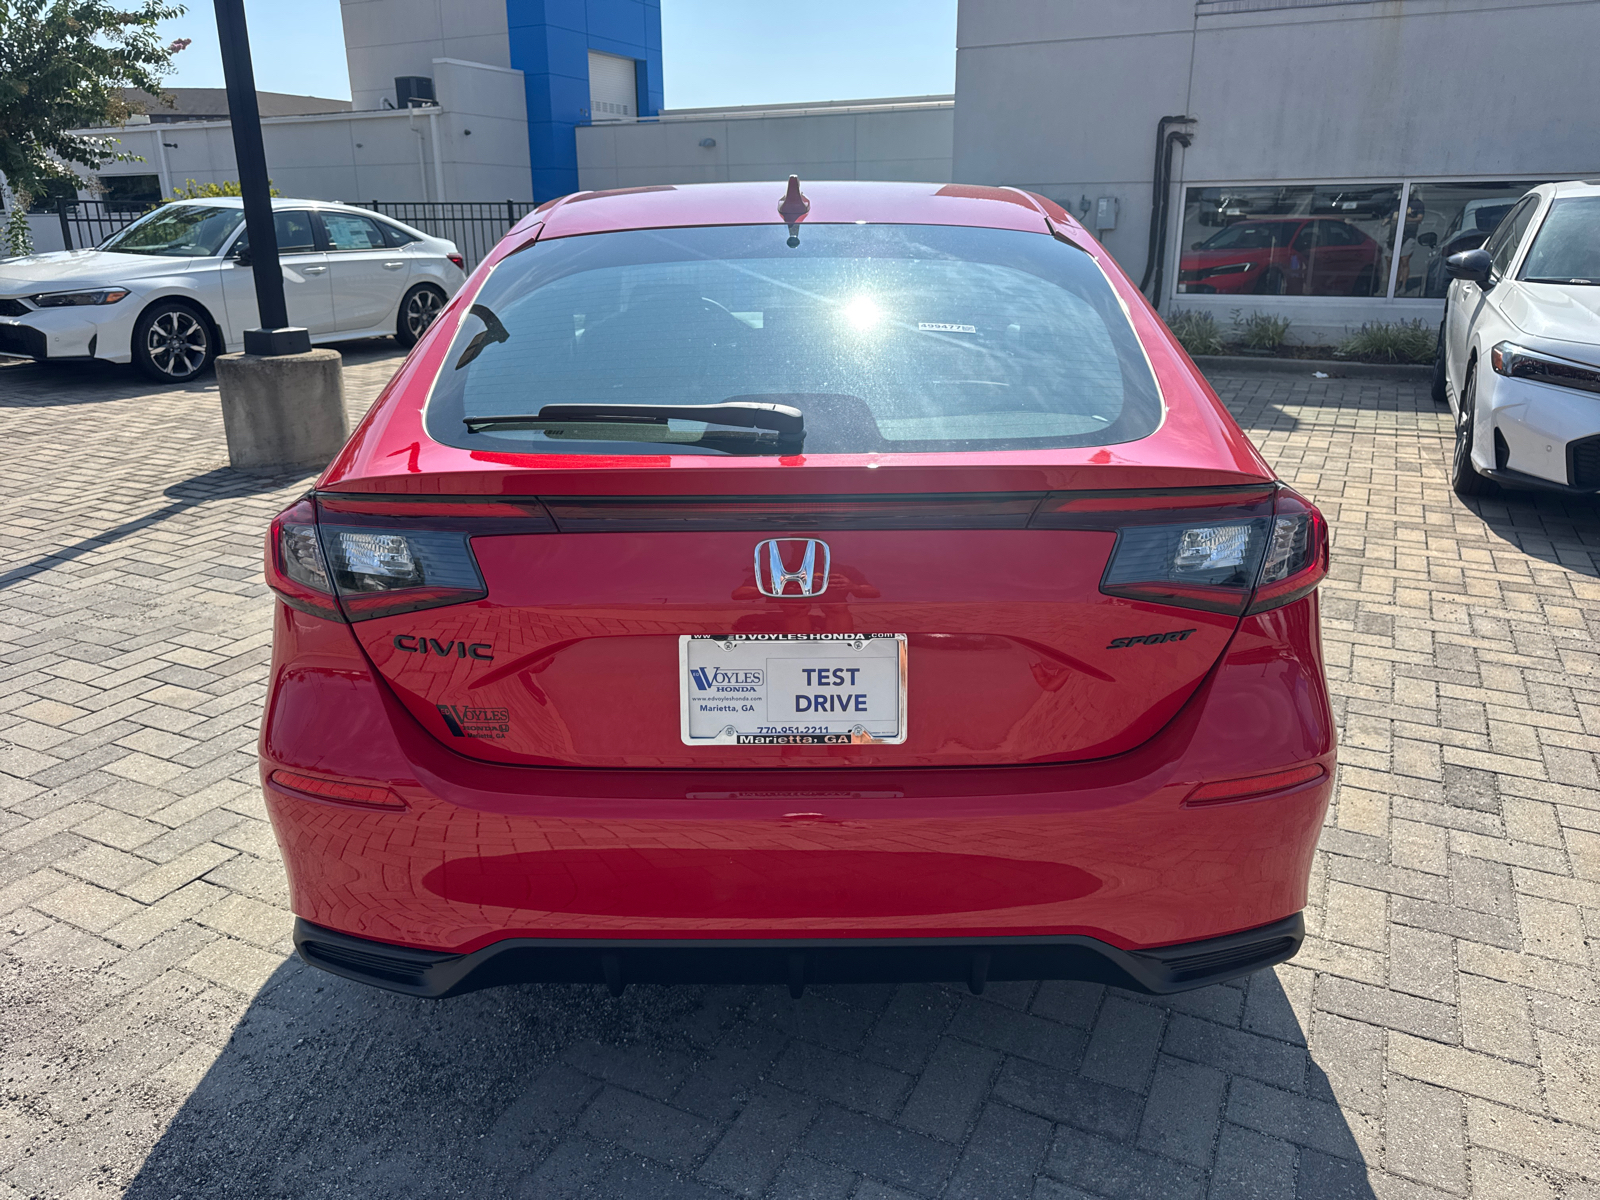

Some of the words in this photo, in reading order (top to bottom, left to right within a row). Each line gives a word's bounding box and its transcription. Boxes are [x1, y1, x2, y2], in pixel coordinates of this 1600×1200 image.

[393, 634, 494, 661] CIVIC
[1106, 628, 1197, 650] SPORT
[699, 667, 761, 688] VOYLES
[802, 668, 860, 686] TEST
[700, 704, 738, 712] Marietta,
[741, 704, 755, 712] GA
[795, 694, 868, 712] DRIVE
[450, 705, 508, 724] VOYLES
[740, 735, 818, 743] Marietta,
[824, 735, 849, 743] GA
